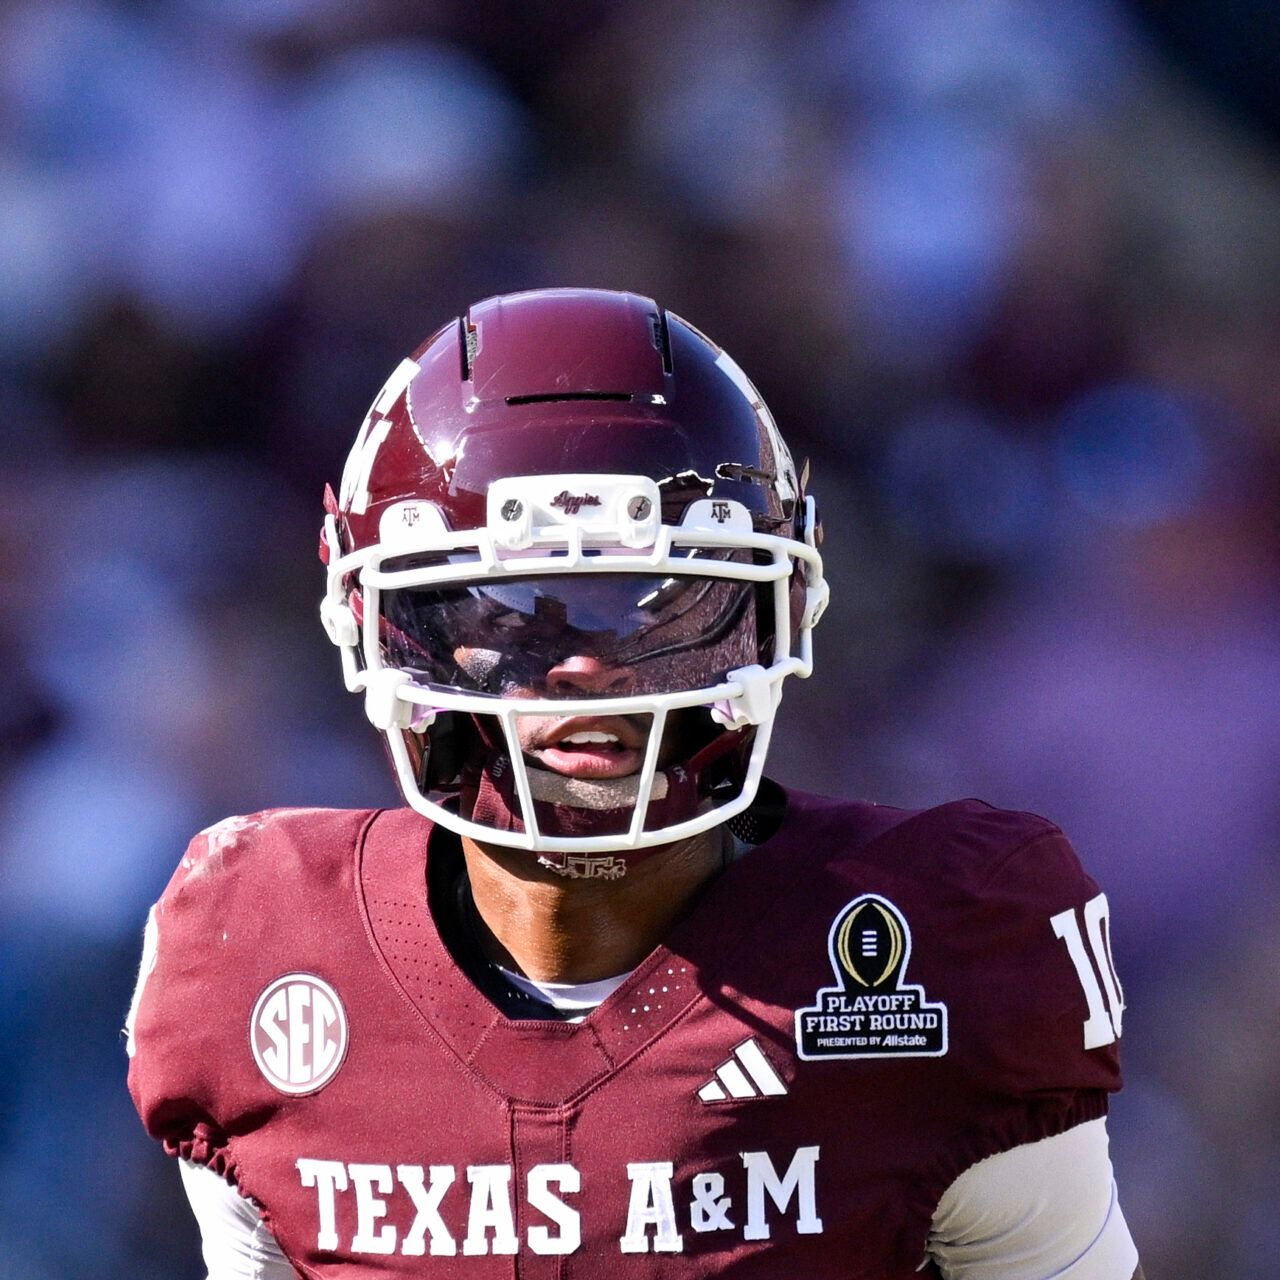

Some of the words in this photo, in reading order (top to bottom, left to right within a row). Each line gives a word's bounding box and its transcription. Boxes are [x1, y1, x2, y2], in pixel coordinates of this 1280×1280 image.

[549, 490, 603, 515] Aggies
[1050, 891, 1126, 1051] 10
[826, 994, 916, 1013] PLAYOFF
[259, 984, 338, 1084] SEC
[805, 1014, 865, 1033] FIRST
[869, 1013, 938, 1031] ROUND
[816, 1036, 868, 1047] PRESENTED
[869, 1036, 882, 1046] BY
[882, 1034, 927, 1047] Allstate
[296, 1157, 582, 1257] TEXAS
[620, 1145, 824, 1254] A&M
